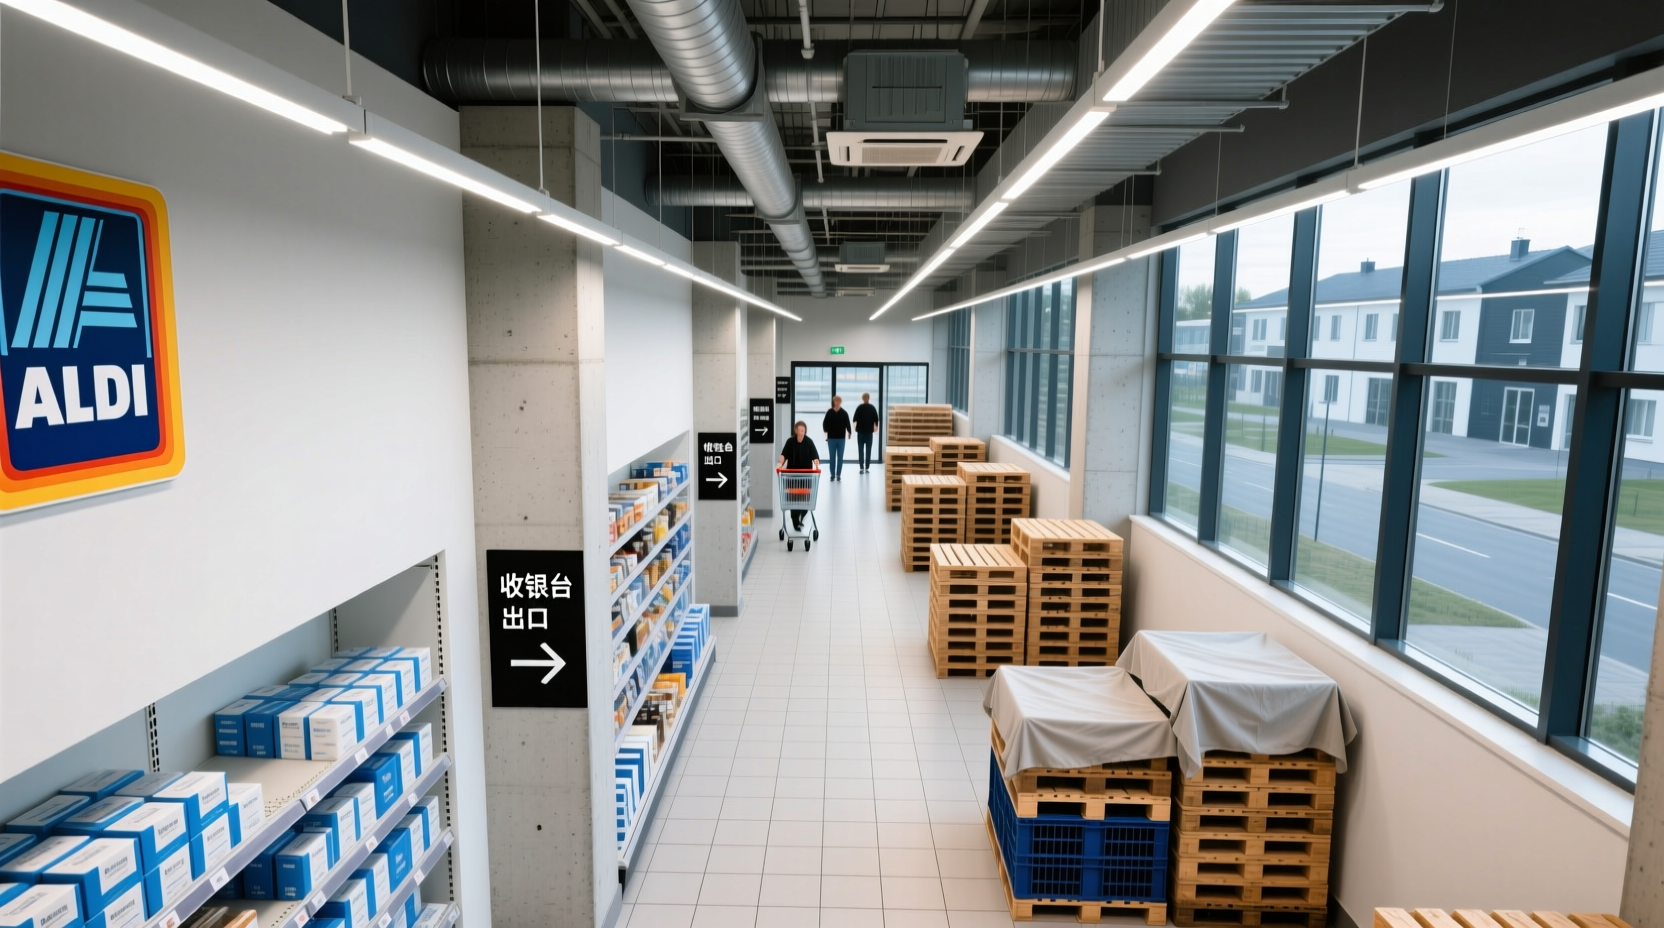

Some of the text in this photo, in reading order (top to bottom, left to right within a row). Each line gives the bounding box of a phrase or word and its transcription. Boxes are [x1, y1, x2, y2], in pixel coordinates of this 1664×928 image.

[15, 364, 148, 429] ALDI
[500, 572, 572, 599] 收银台
[502, 605, 548, 630] 出口
